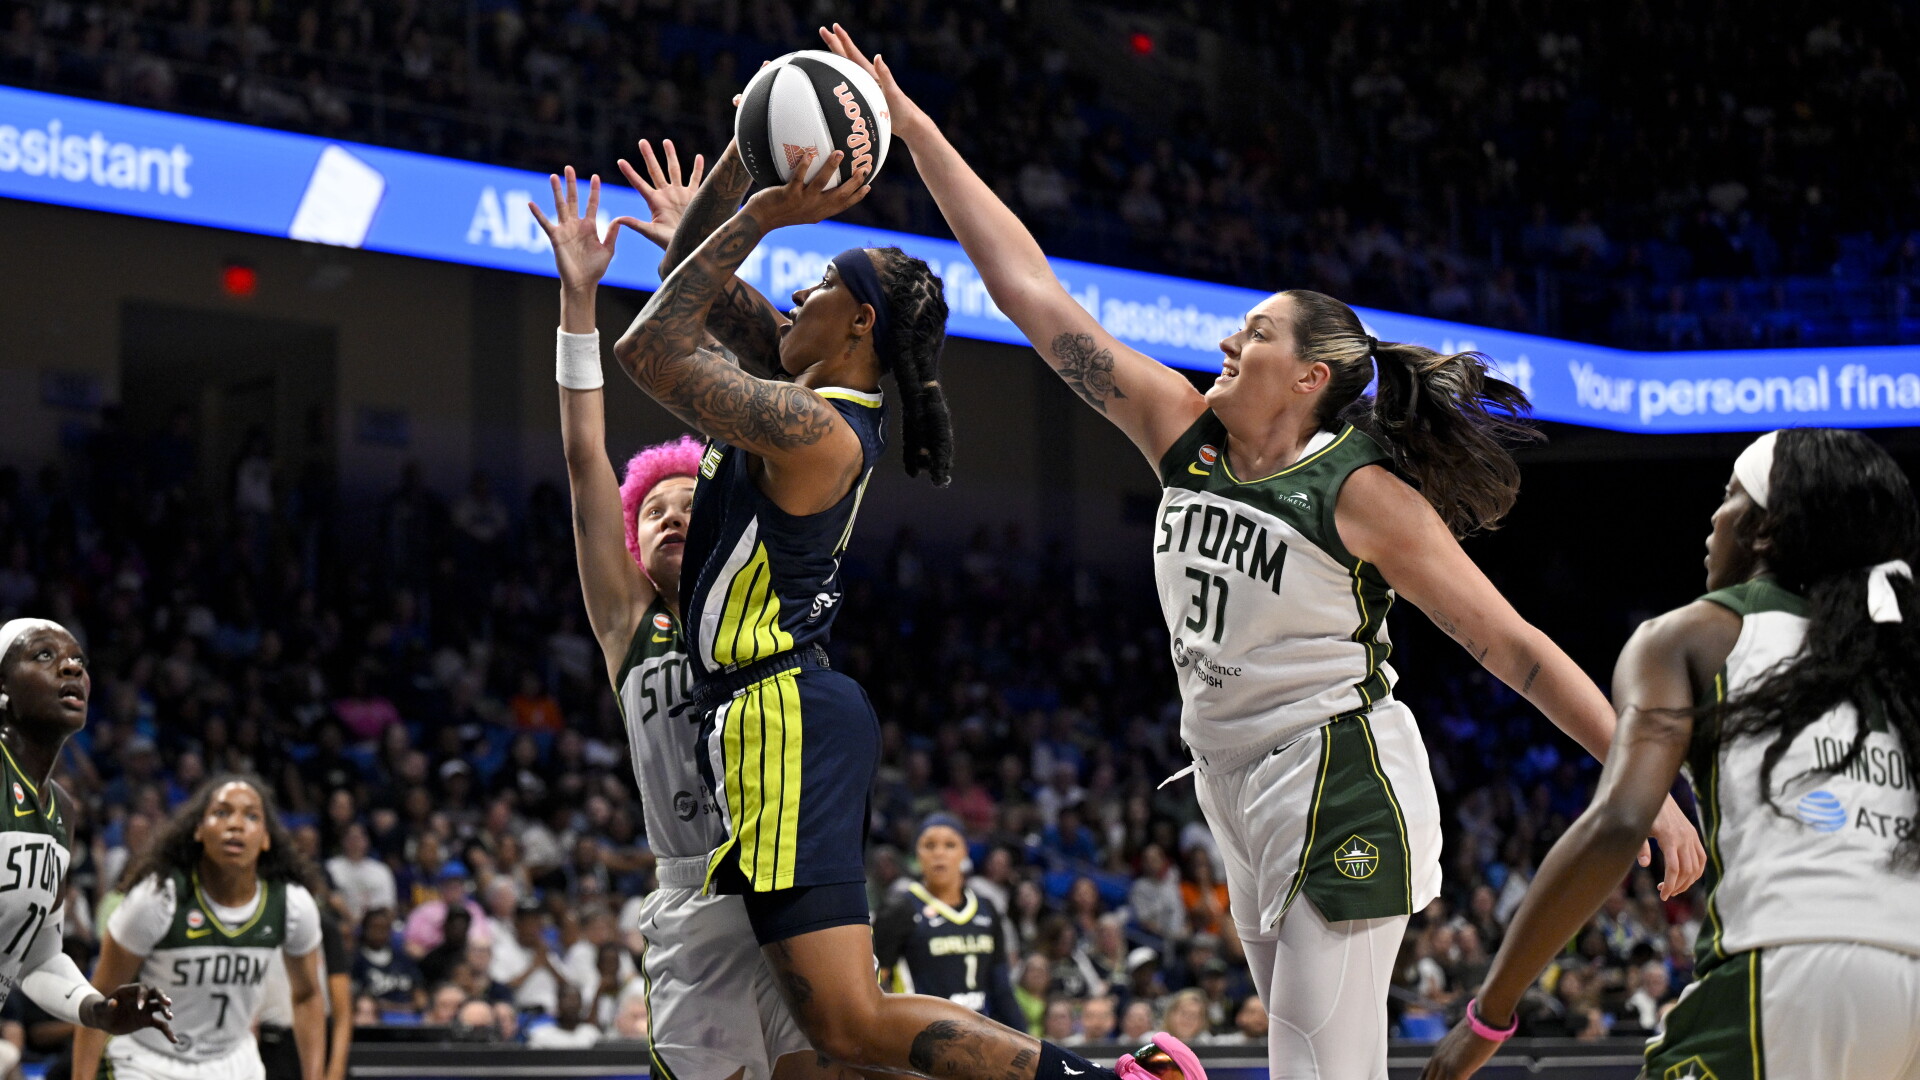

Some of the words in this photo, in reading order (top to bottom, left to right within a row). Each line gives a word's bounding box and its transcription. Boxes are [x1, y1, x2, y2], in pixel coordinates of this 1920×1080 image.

[1103, 296, 1246, 352] assistan
[1568, 359, 1636, 415] Your
[1639, 364, 1830, 425] personal
[1278, 494, 1311, 511] SYMETRA
[1156, 503, 1288, 596] STORM
[1185, 566, 1229, 644] 31
[1194, 658, 1223, 689] WEDISH
[5, 902, 47, 963] 11
[964, 955, 978, 990] 1
[210, 992, 230, 1030] 7
